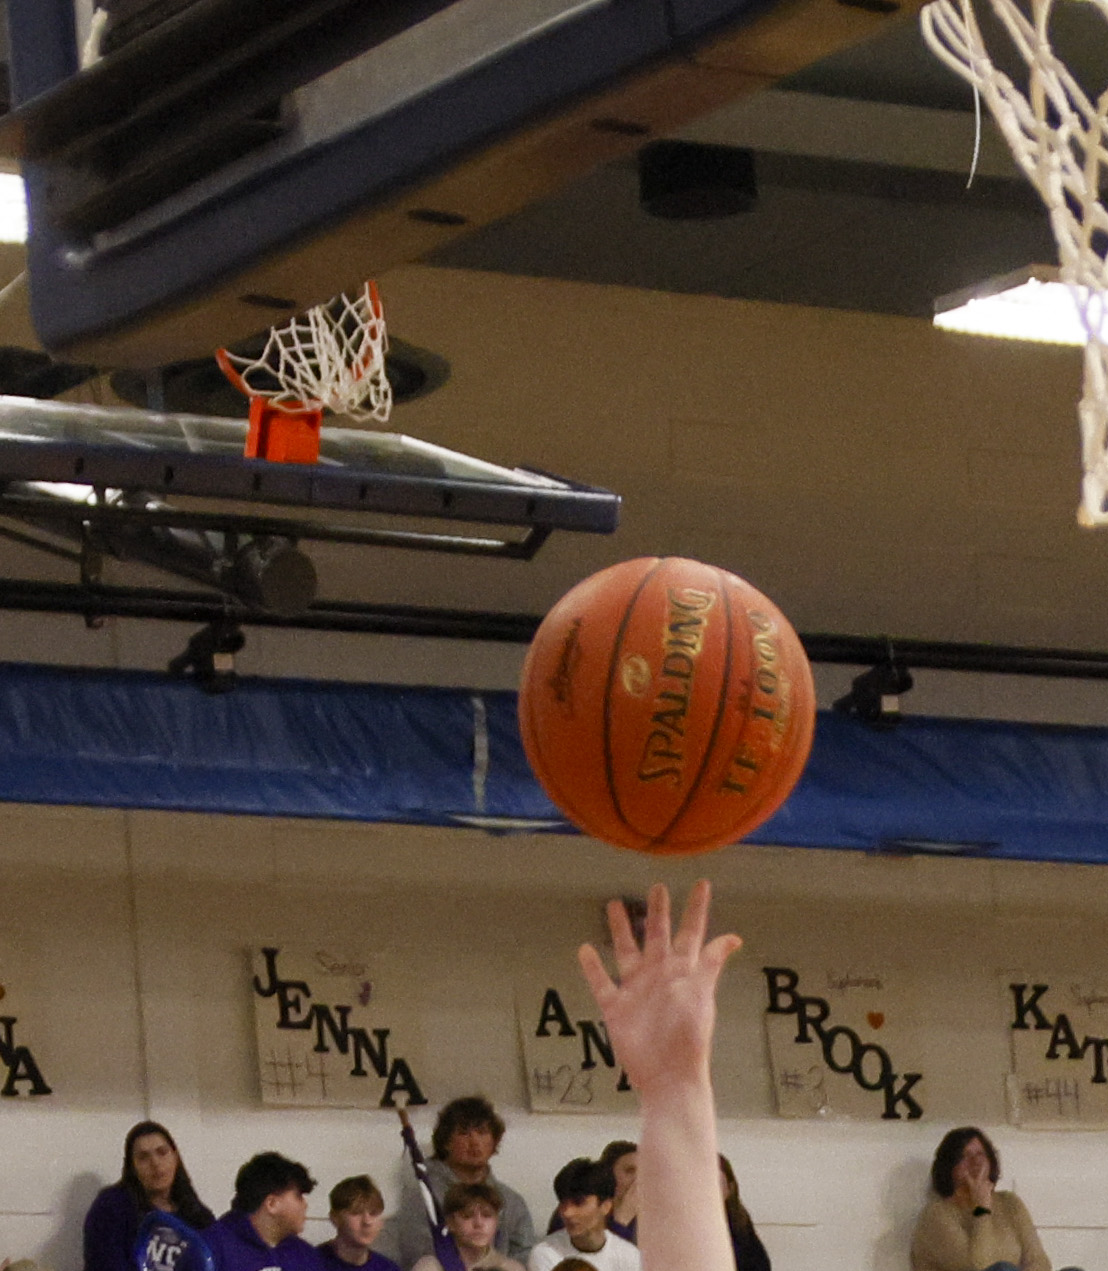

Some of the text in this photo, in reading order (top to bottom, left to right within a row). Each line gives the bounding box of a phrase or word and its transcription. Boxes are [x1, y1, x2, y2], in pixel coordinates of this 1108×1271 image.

[637, 588, 715, 787] SPALDING
[254, 947, 428, 1107] JENNA
[262, 1044, 330, 1099] #4
[536, 987, 631, 1091] AN
[763, 966, 923, 1119] BROOK
